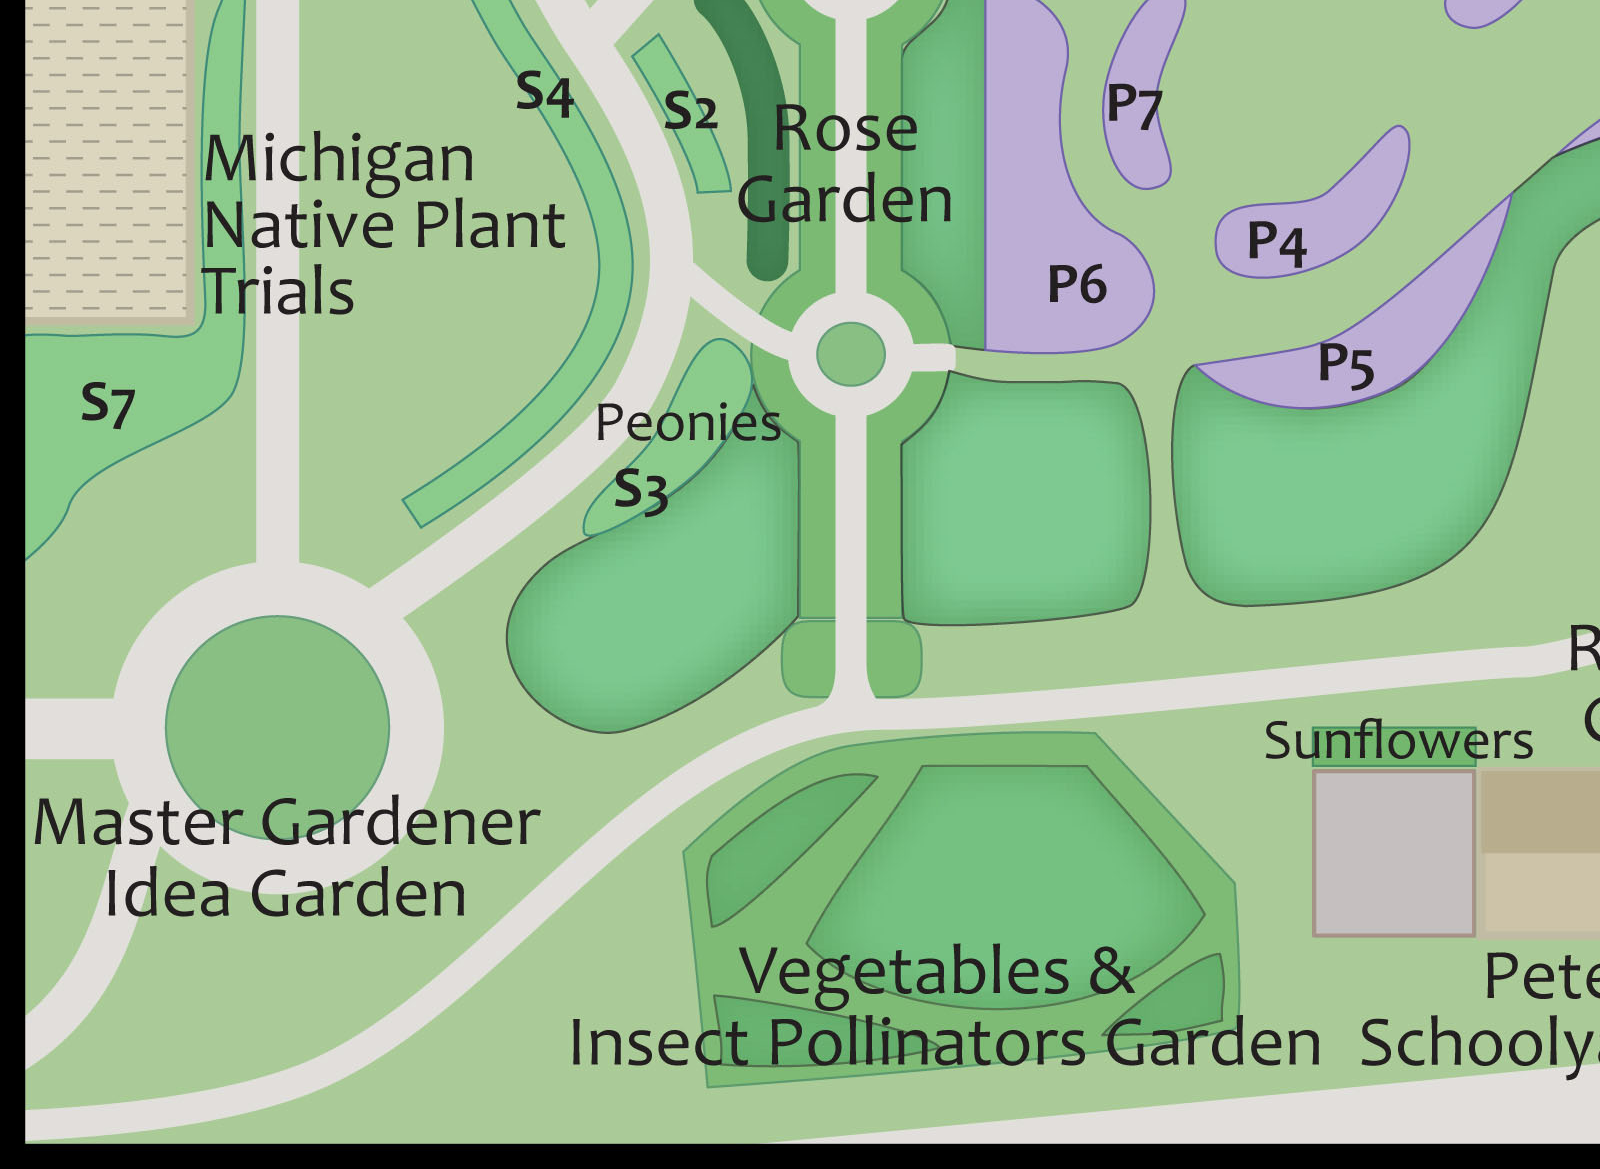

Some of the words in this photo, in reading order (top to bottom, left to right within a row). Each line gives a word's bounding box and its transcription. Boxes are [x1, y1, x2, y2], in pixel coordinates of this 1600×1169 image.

[515, 70, 576, 119] S4
[663, 90, 719, 130] S2
[1107, 83, 1164, 131] P7
[774, 103, 919, 152] Rose
[204, 130, 474, 199] Michigan
[737, 171, 952, 223] Garden
[205, 199, 395, 249] Native
[416, 197, 567, 249] Plant
[1248, 220, 1309, 269] P4
[199, 263, 355, 315] Trials
[1048, 263, 1108, 304] P6
[1319, 342, 1376, 392] P5
[80, 381, 137, 430] S7
[596, 399, 782, 442] Peonies
[614, 467, 670, 518] S3
[1264, 717, 1535, 760] Sunflowers
[33, 798, 245, 846] Master
[261, 794, 543, 846] Gardener
[107, 865, 230, 917] Idea
[250, 865, 466, 917] Garden
[737, 943, 1071, 1012] Vegetables
[1088, 946, 1137, 995] &
[571, 1016, 750, 1067] Insect
[770, 1014, 1087, 1067] Pollinators
[1105, 1014, 1321, 1066] Garden
